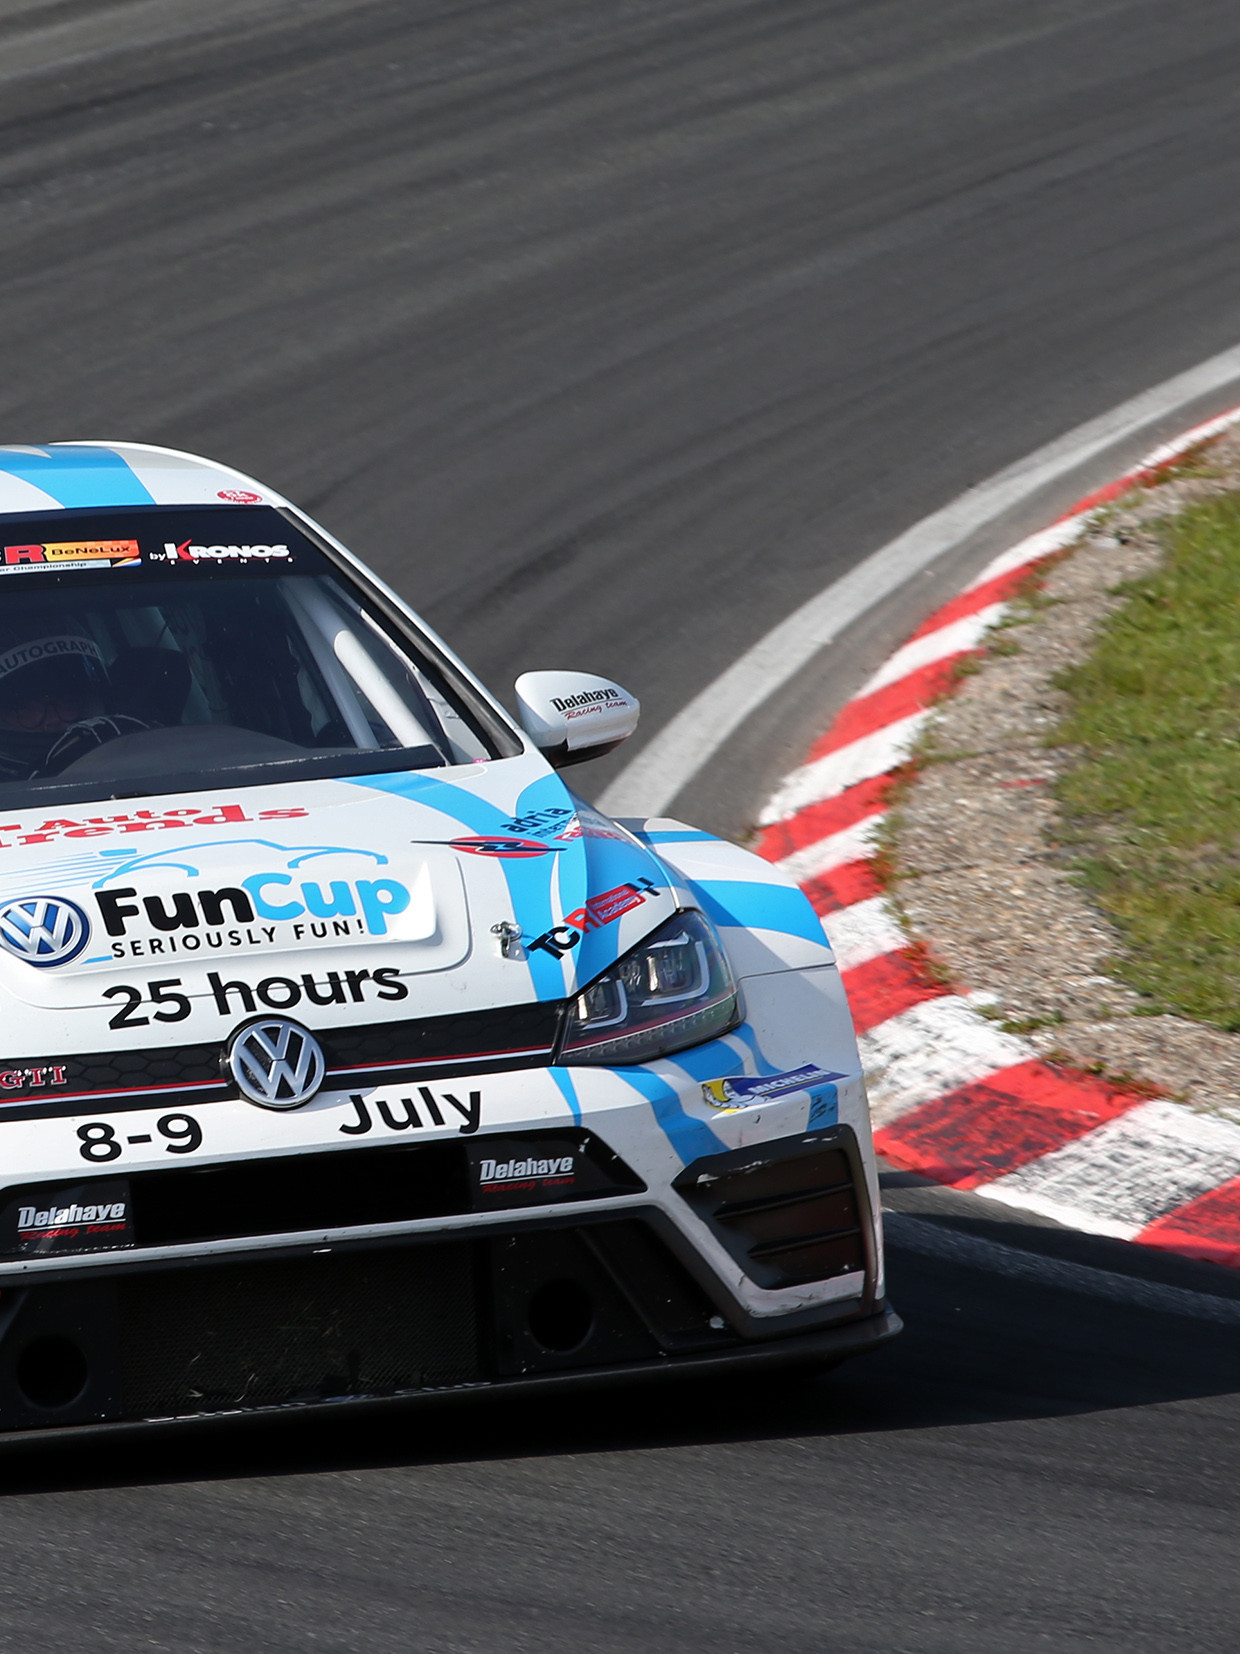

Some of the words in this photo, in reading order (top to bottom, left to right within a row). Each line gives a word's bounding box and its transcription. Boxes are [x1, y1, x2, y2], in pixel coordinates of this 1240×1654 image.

[52, 546, 130, 556] BeNeLux
[150, 552, 166, 561] by
[164, 539, 290, 561] KRONOS
[549, 688, 619, 712] Delahaye
[564, 704, 603, 720] Racing
[605, 700, 628, 710] team
[34, 809, 202, 833] Auto
[95, 872, 411, 937] FunCup
[111, 925, 278, 959] SERIOUSLY
[294, 918, 365, 941] FUN!
[526, 907, 602, 961] TCR
[102, 977, 192, 1031] 25
[207, 967, 410, 1016] hours
[747, 1069, 832, 1094] MICHELIN
[339, 1086, 482, 1135] July
[76, 1113, 203, 1163] 8-9
[479, 1156, 575, 1181] Delahaye
[18, 1202, 126, 1229] Delahaye
[20, 1226, 79, 1241] Racing
[86, 1223, 127, 1235] team
